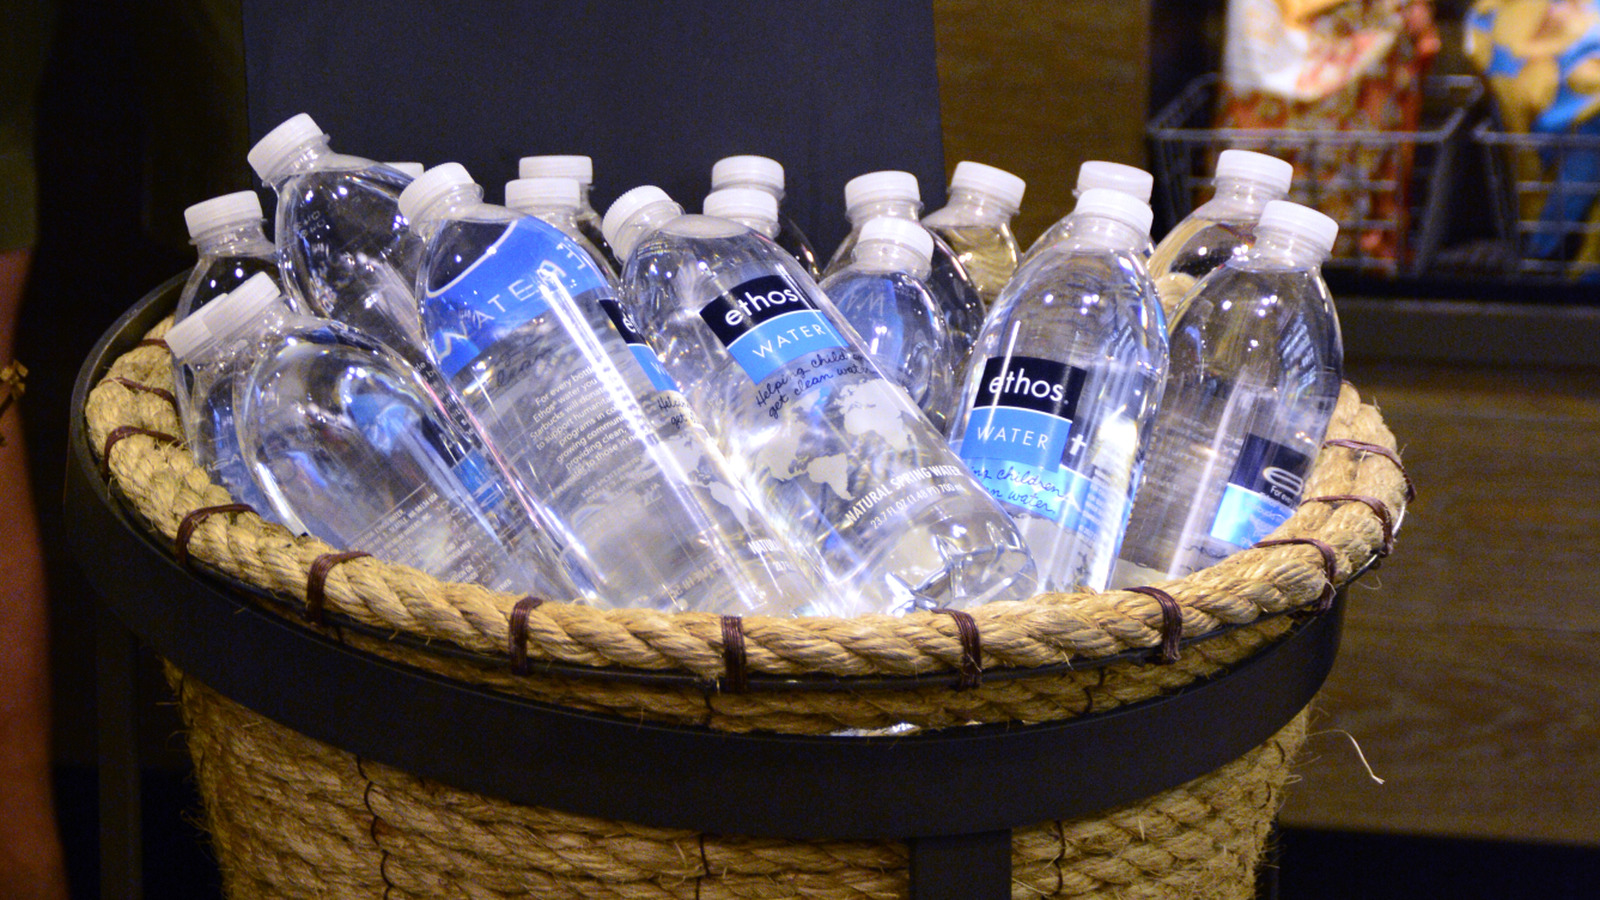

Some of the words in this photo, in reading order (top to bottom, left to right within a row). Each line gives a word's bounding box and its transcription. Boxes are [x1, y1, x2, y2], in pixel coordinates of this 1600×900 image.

[725, 288, 799, 326] ethos
[752, 323, 826, 359] WATER
[535, 393, 549, 405] For
[550, 381, 572, 397] every
[571, 365, 594, 382] bottl
[558, 388, 580, 403] water
[581, 378, 597, 391] you
[756, 366, 810, 408] Helpig
[769, 392, 790, 419] get
[794, 373, 833, 397] clean
[988, 367, 1064, 402] ethos
[528, 412, 566, 439] Starbucks
[564, 401, 578, 413] will
[578, 383, 606, 404] donat
[558, 419, 596, 446] programs
[595, 411, 604, 420] in
[536, 441, 545, 449] to
[543, 419, 575, 443] support
[554, 438, 588, 463] growing
[564, 442, 602, 469] providing
[601, 426, 626, 444] clean,
[585, 457, 595, 467] to
[595, 444, 618, 460] those
[618, 437, 627, 446] in
[976, 426, 1049, 450] WATER
[844, 484, 893, 524] NATURAL
[890, 466, 932, 490] SPRING
[928, 464, 964, 477] WATER
[996, 466, 1064, 498] children
[871, 511, 888, 530] 23.7
[886, 505, 897, 517] FL
[895, 498, 909, 511] OZ
[938, 483, 956, 494] 700
